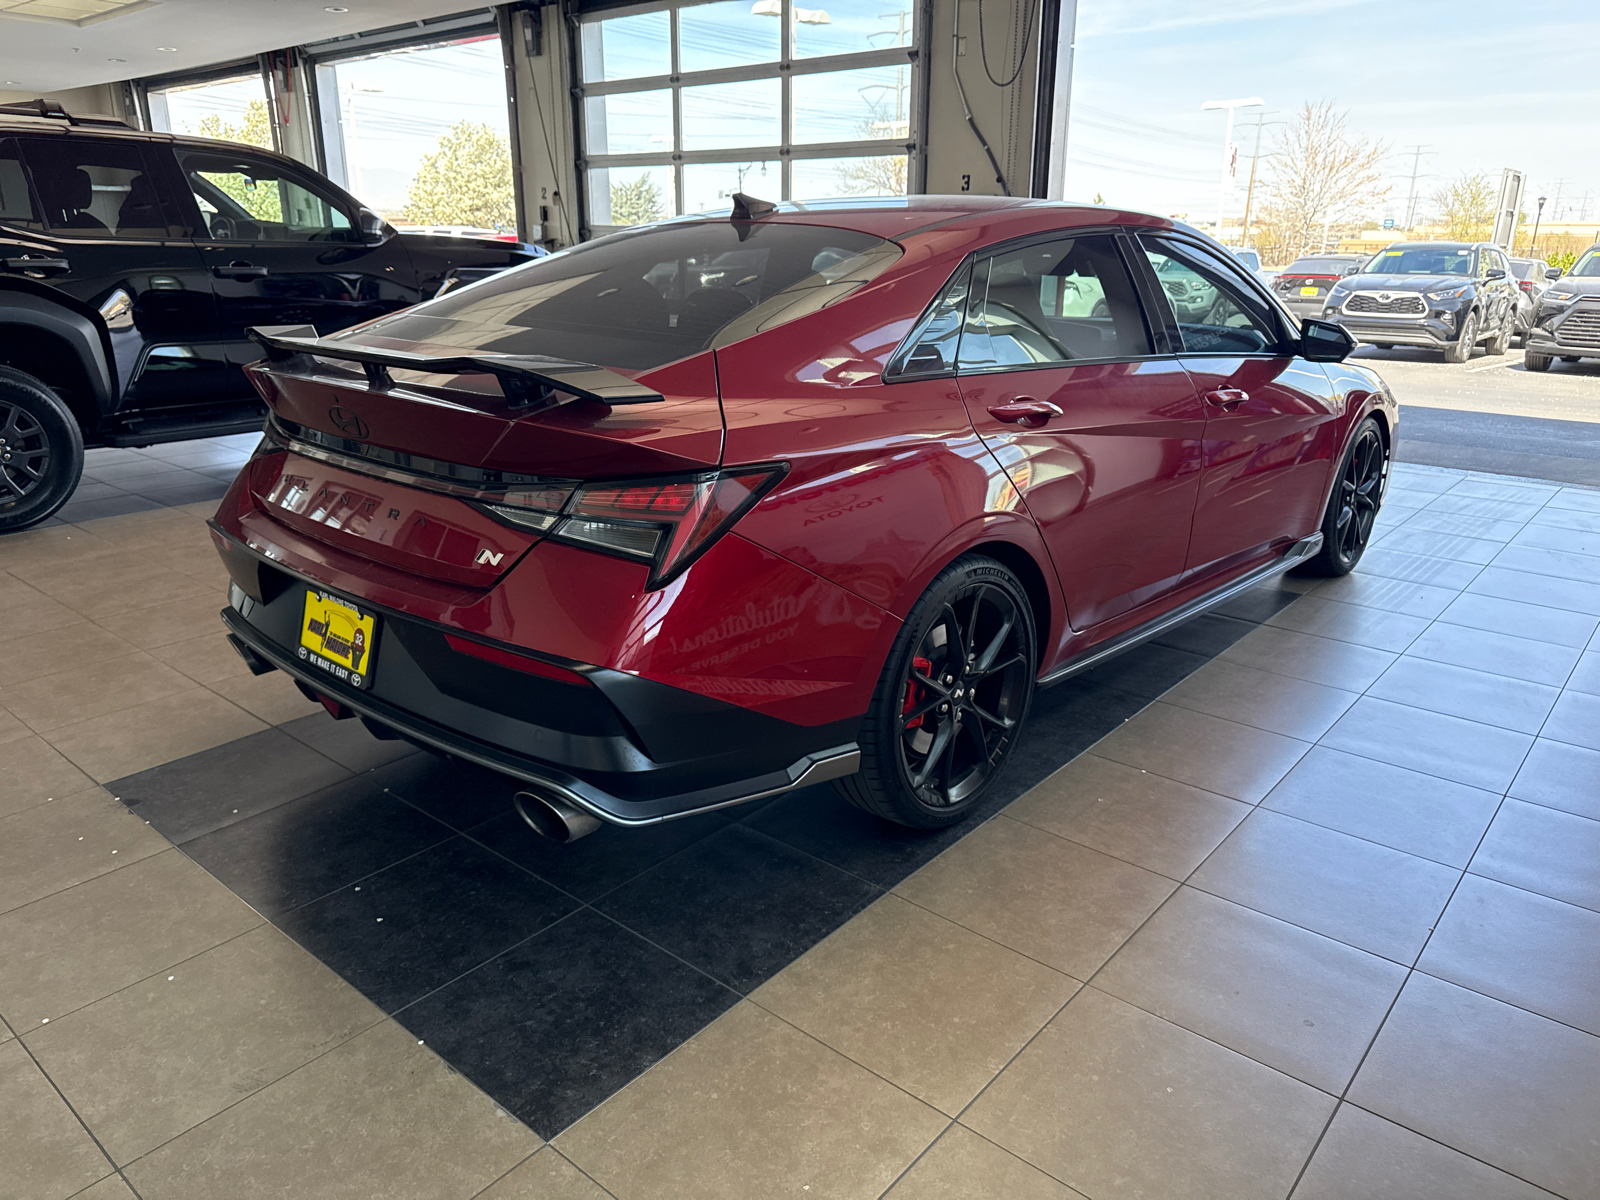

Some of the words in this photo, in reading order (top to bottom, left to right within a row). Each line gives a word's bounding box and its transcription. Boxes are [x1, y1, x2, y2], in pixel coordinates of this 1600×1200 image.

[961, 174, 971, 191] 3
[541, 187, 547, 200] 2
[284, 474, 427, 527] ELANTRA
[474, 548, 504, 566] N
[976, 568, 1009, 580] MICHELIN
[355, 633, 364, 645] 32
[310, 653, 317, 664] WE
[317, 657, 330, 670] MAKE
[330, 664, 336, 673] IT
[336, 666, 348, 680] EASY
